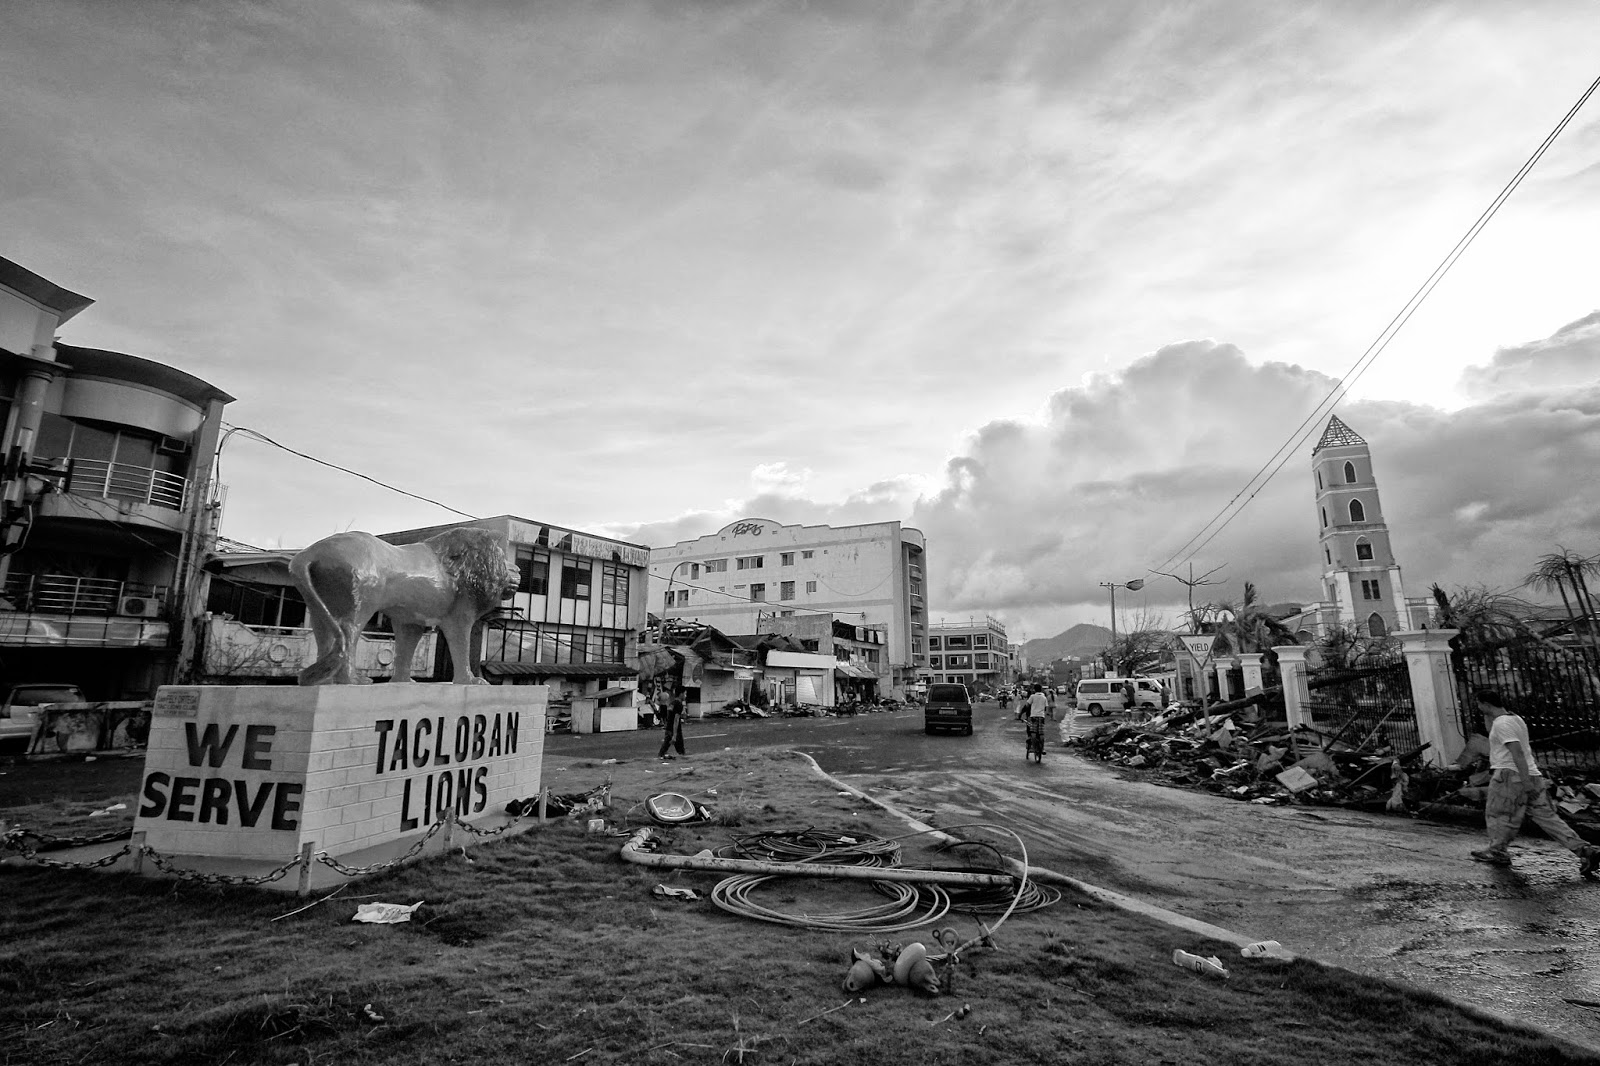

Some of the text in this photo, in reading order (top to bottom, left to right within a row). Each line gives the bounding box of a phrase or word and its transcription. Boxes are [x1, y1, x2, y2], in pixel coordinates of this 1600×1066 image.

[1189, 643, 1209, 652] YIELD
[185, 722, 276, 771] WE
[374, 711, 519, 774] TACLOBAN
[139, 771, 303, 831] SERVE
[400, 766, 488, 833] LIONS
